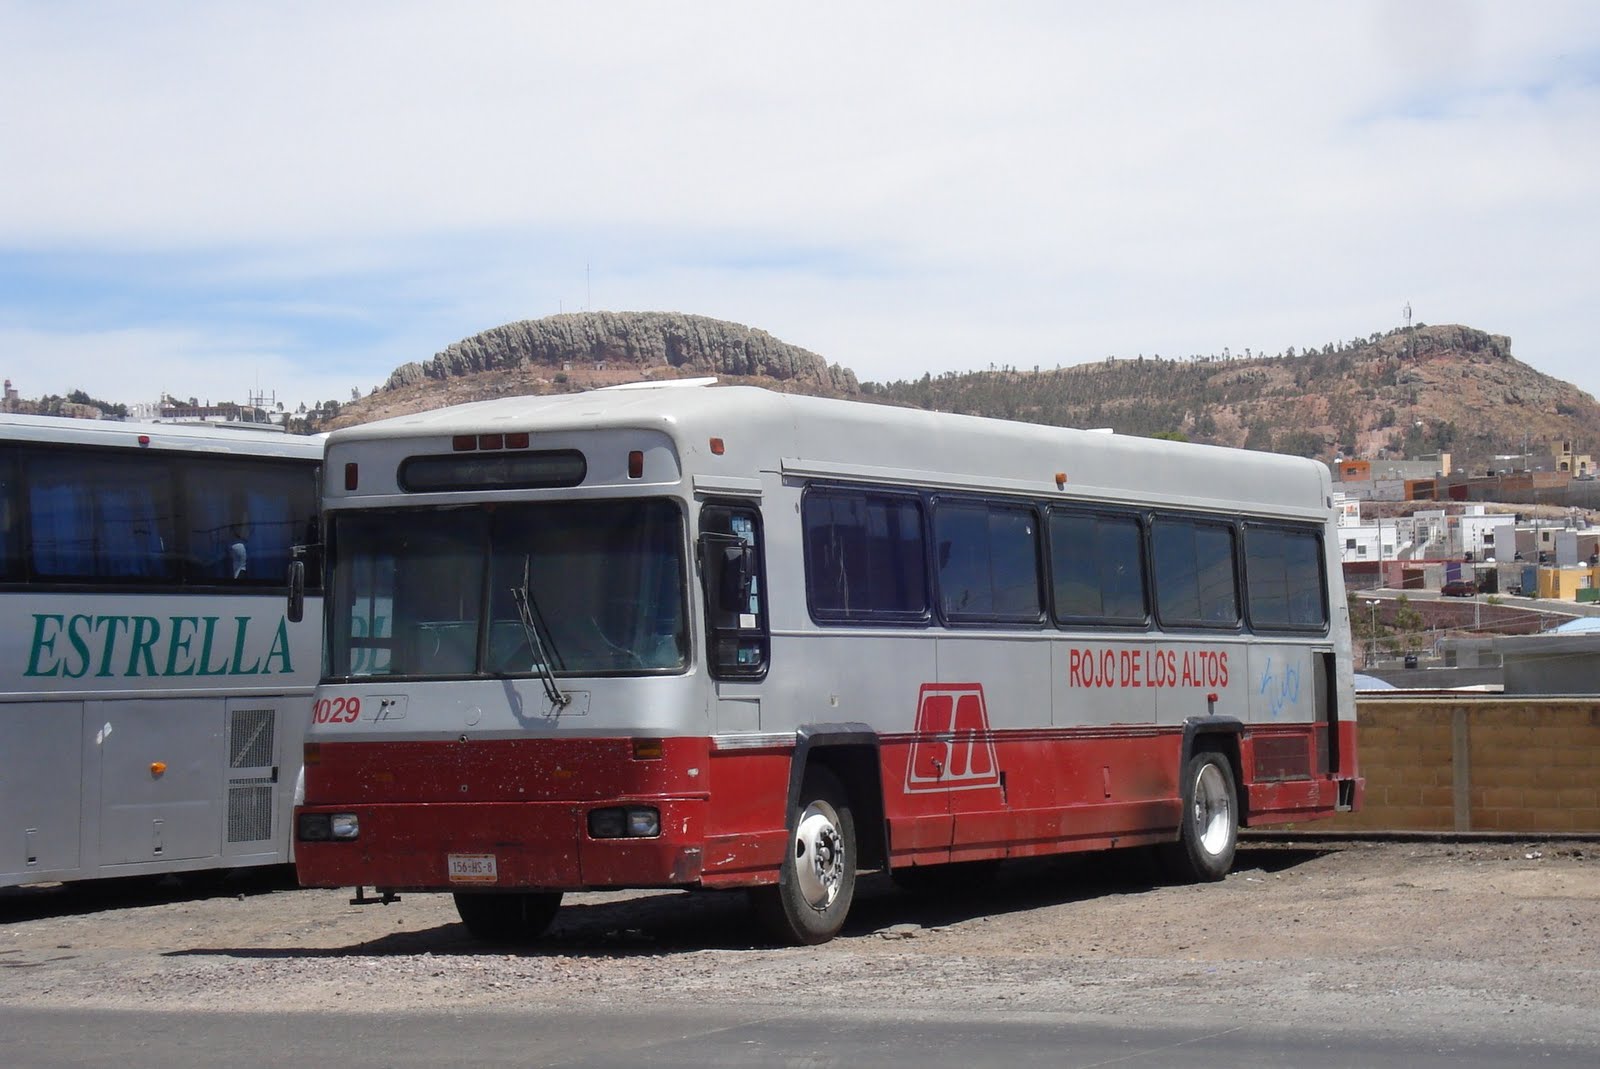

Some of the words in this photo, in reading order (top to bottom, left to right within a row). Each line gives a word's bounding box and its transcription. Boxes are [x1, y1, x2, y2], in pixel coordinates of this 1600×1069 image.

[23, 613, 295, 679] ESTRELLA
[1069, 648, 1115, 688] ROJO
[1120, 649, 1141, 688] DE
[1146, 649, 1177, 688] LOS
[1181, 650, 1229, 688] ALTOS
[312, 697, 361, 724] 1029
